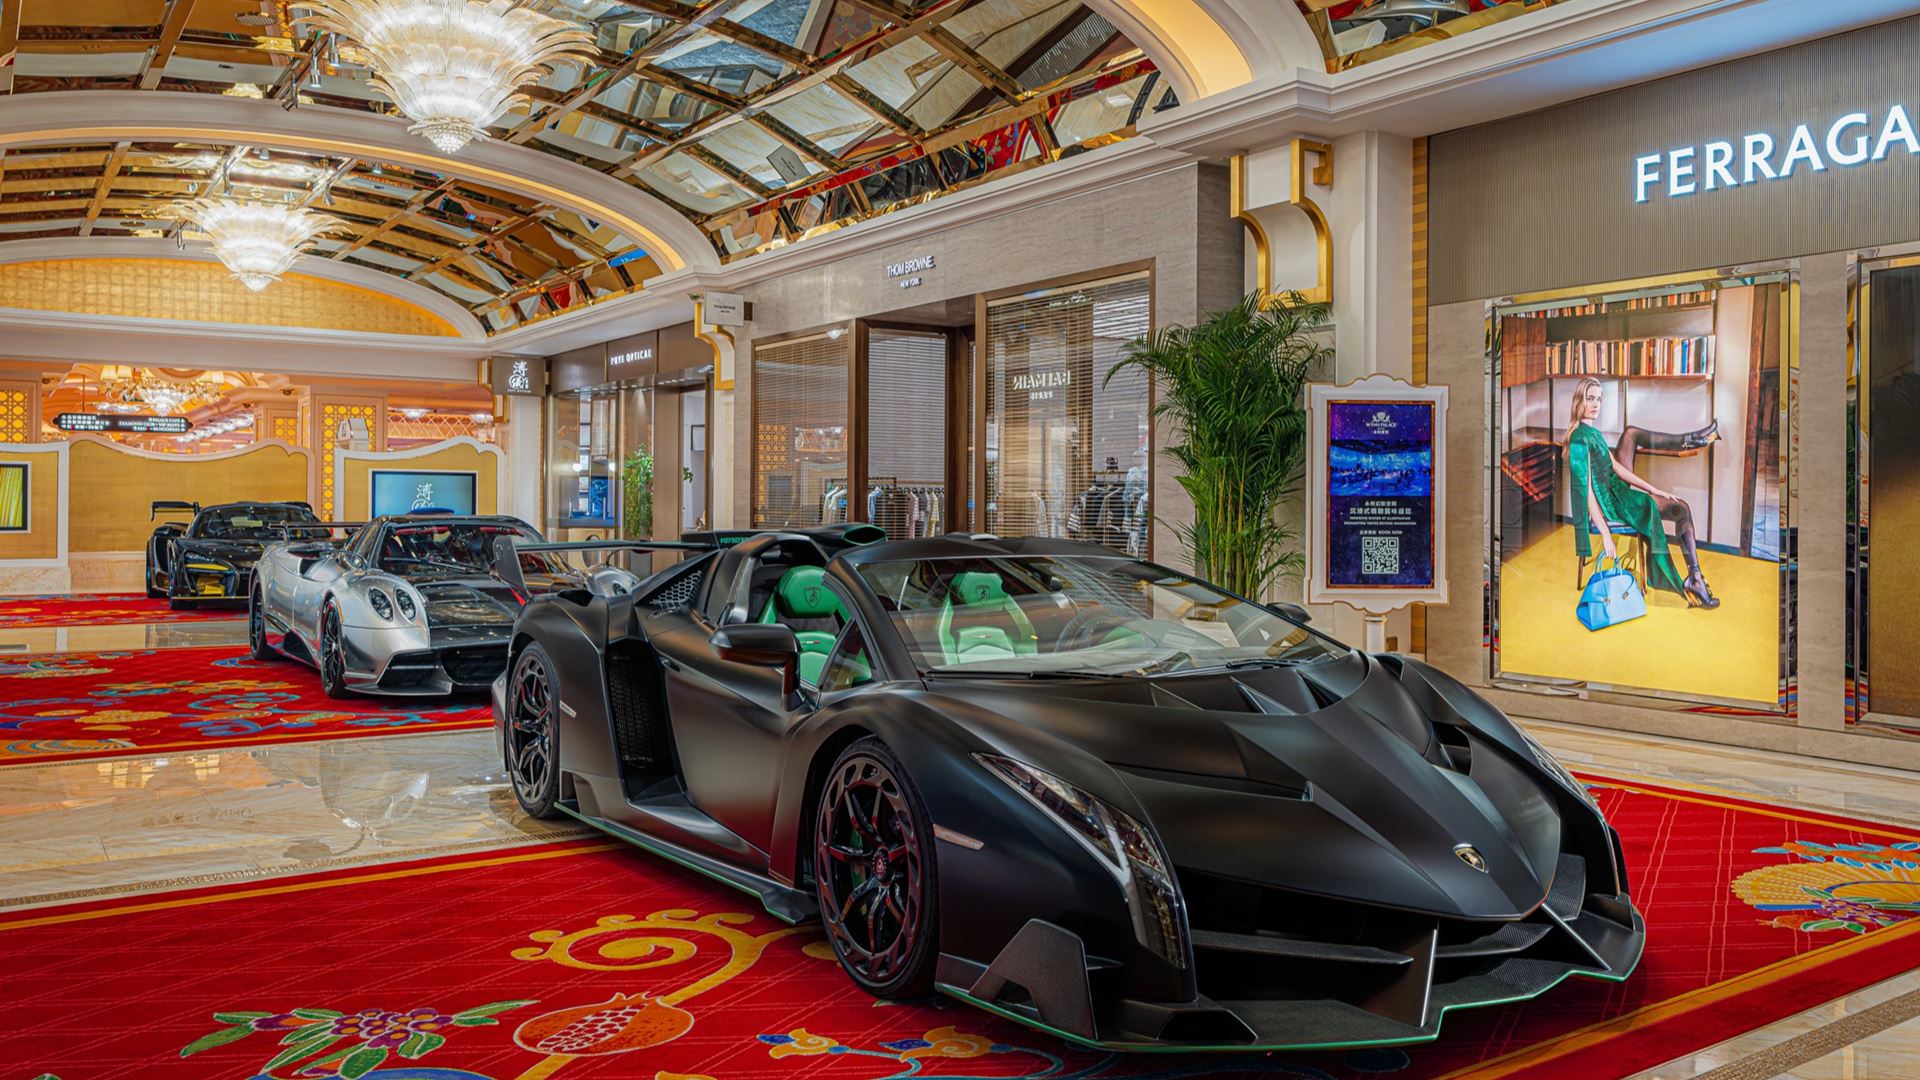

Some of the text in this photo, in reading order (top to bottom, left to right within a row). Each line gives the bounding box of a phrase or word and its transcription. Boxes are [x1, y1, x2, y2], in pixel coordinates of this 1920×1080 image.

[1635, 104, 1920, 202] FERRAGA
[886, 262, 905, 278] THOM
[626, 348, 652, 363] OPTICAL
